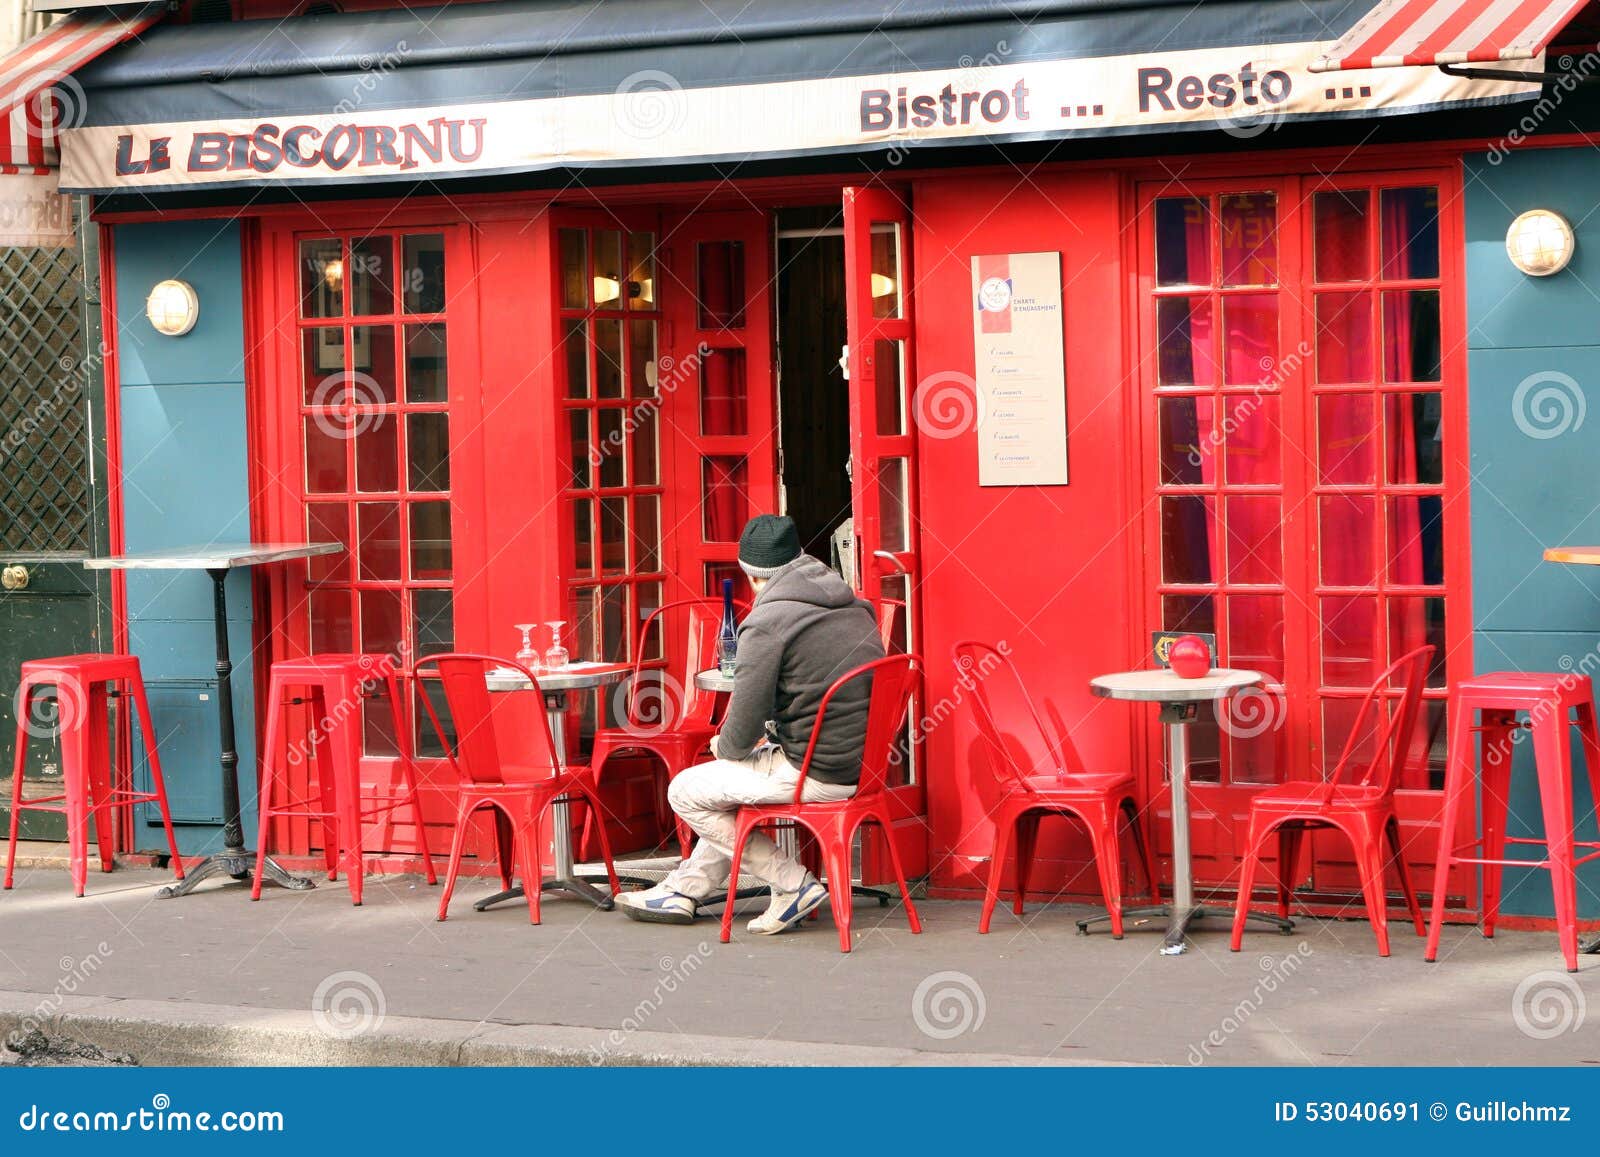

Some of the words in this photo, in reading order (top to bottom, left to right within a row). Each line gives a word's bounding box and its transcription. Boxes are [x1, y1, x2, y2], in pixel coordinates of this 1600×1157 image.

[860, 77, 1030, 132] Bistrot
[1137, 62, 1293, 113] Resto
[115, 134, 172, 177] LE
[187, 116, 488, 173] BISCORNU
